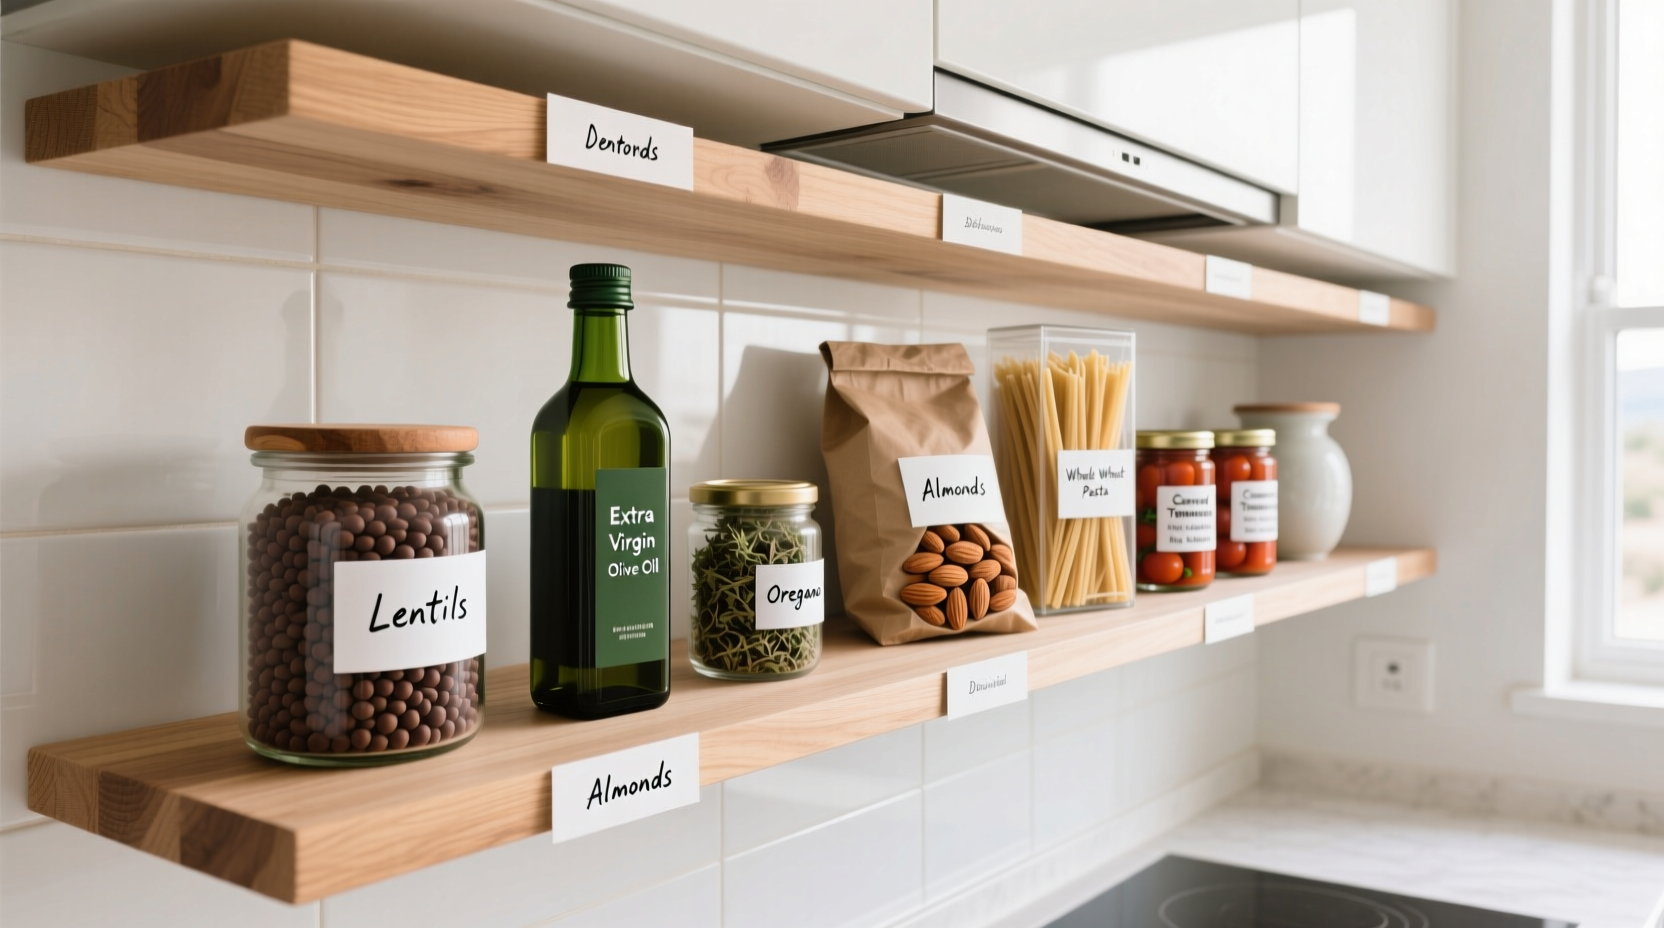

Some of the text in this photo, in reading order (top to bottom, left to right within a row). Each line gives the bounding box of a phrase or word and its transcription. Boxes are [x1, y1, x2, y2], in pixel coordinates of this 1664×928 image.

[922, 475, 986, 502] Almonds
[610, 505, 654, 526] Extra
[608, 531, 655, 557] Virgin
[608, 561, 640, 577] Olive
[369, 585, 467, 633] Lentils
[767, 584, 821, 611] Oregano
[586, 759, 672, 810] Almonds
